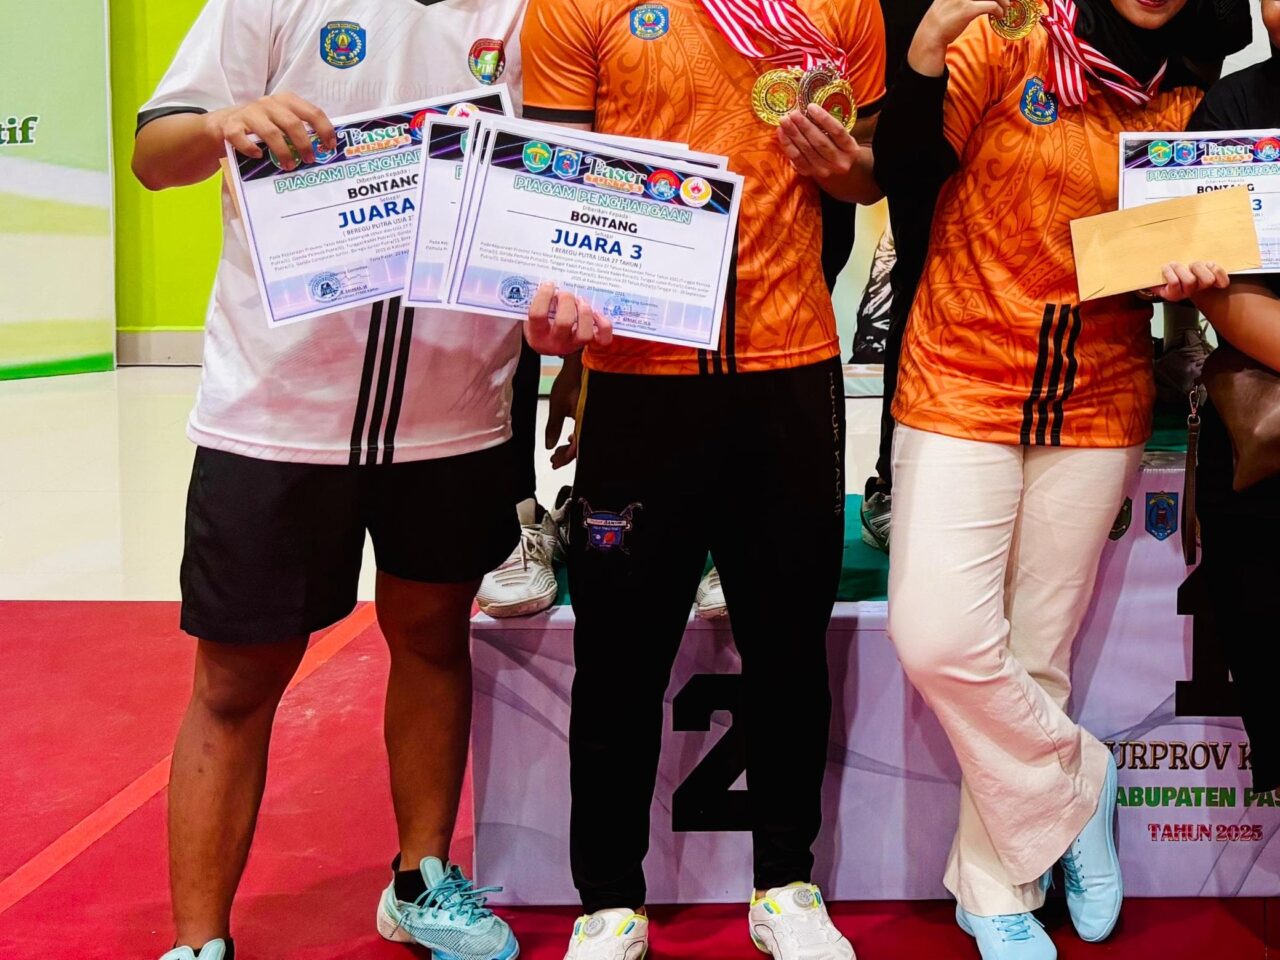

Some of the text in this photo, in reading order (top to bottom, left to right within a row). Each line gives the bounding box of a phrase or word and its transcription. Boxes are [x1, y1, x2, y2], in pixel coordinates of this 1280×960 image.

[337, 123, 410, 148] Paser
[1199, 142, 1254, 156] Paser
[274, 165, 345, 193] PIAGAM
[585, 156, 647, 185] Paser
[1146, 168, 1198, 182] PIAGAM
[513, 175, 692, 225] PIAGAM PENGHARGAAN
[1252, 199, 1262, 211] 3
[338, 197, 416, 229] JUARA
[571, 211, 638, 234] BONTANG
[551, 229, 643, 260] JUARA 3
[1109, 741, 1231, 770] URPROV
[1117, 787, 1236, 808] ABUPATEN
[1148, 824, 1263, 842] TAHUN 2025
